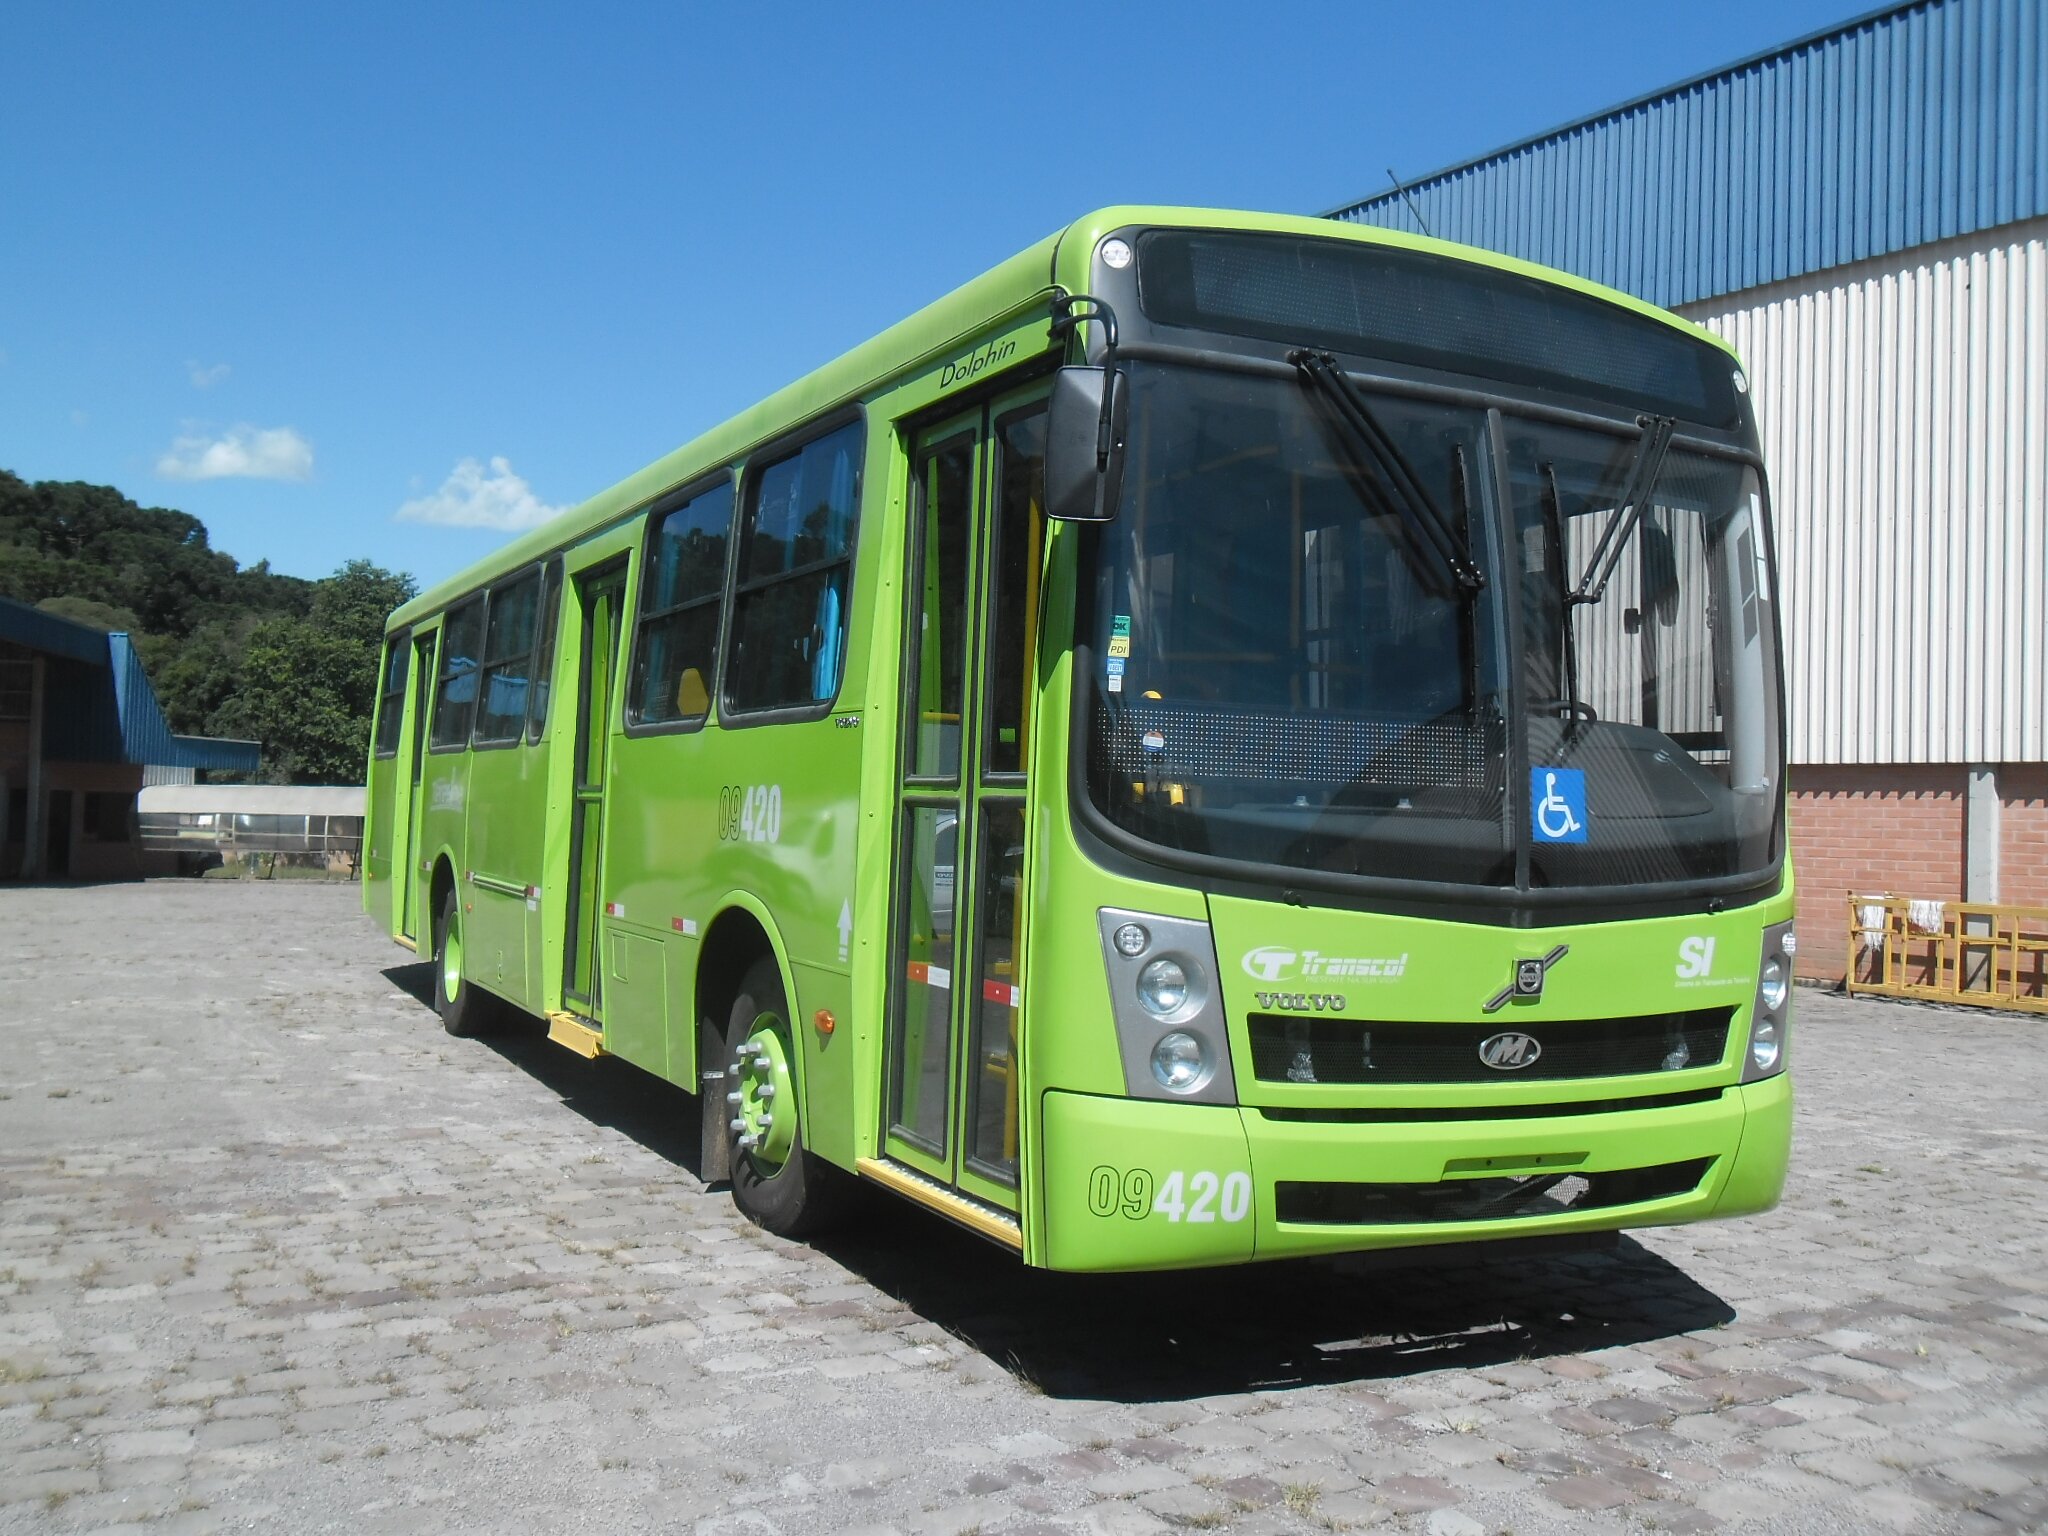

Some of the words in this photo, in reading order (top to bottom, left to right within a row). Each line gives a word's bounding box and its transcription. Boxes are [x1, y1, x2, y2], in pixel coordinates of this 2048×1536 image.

[940, 341, 1016, 389] Dolphin
[1110, 645, 1127, 654] PDI
[719, 784, 782, 844] 09420
[1301, 950, 1409, 977] Transcol
[1675, 936, 1716, 979] SI
[1254, 991, 1346, 1012] VOLVO
[1088, 1165, 1251, 1223] 09420
